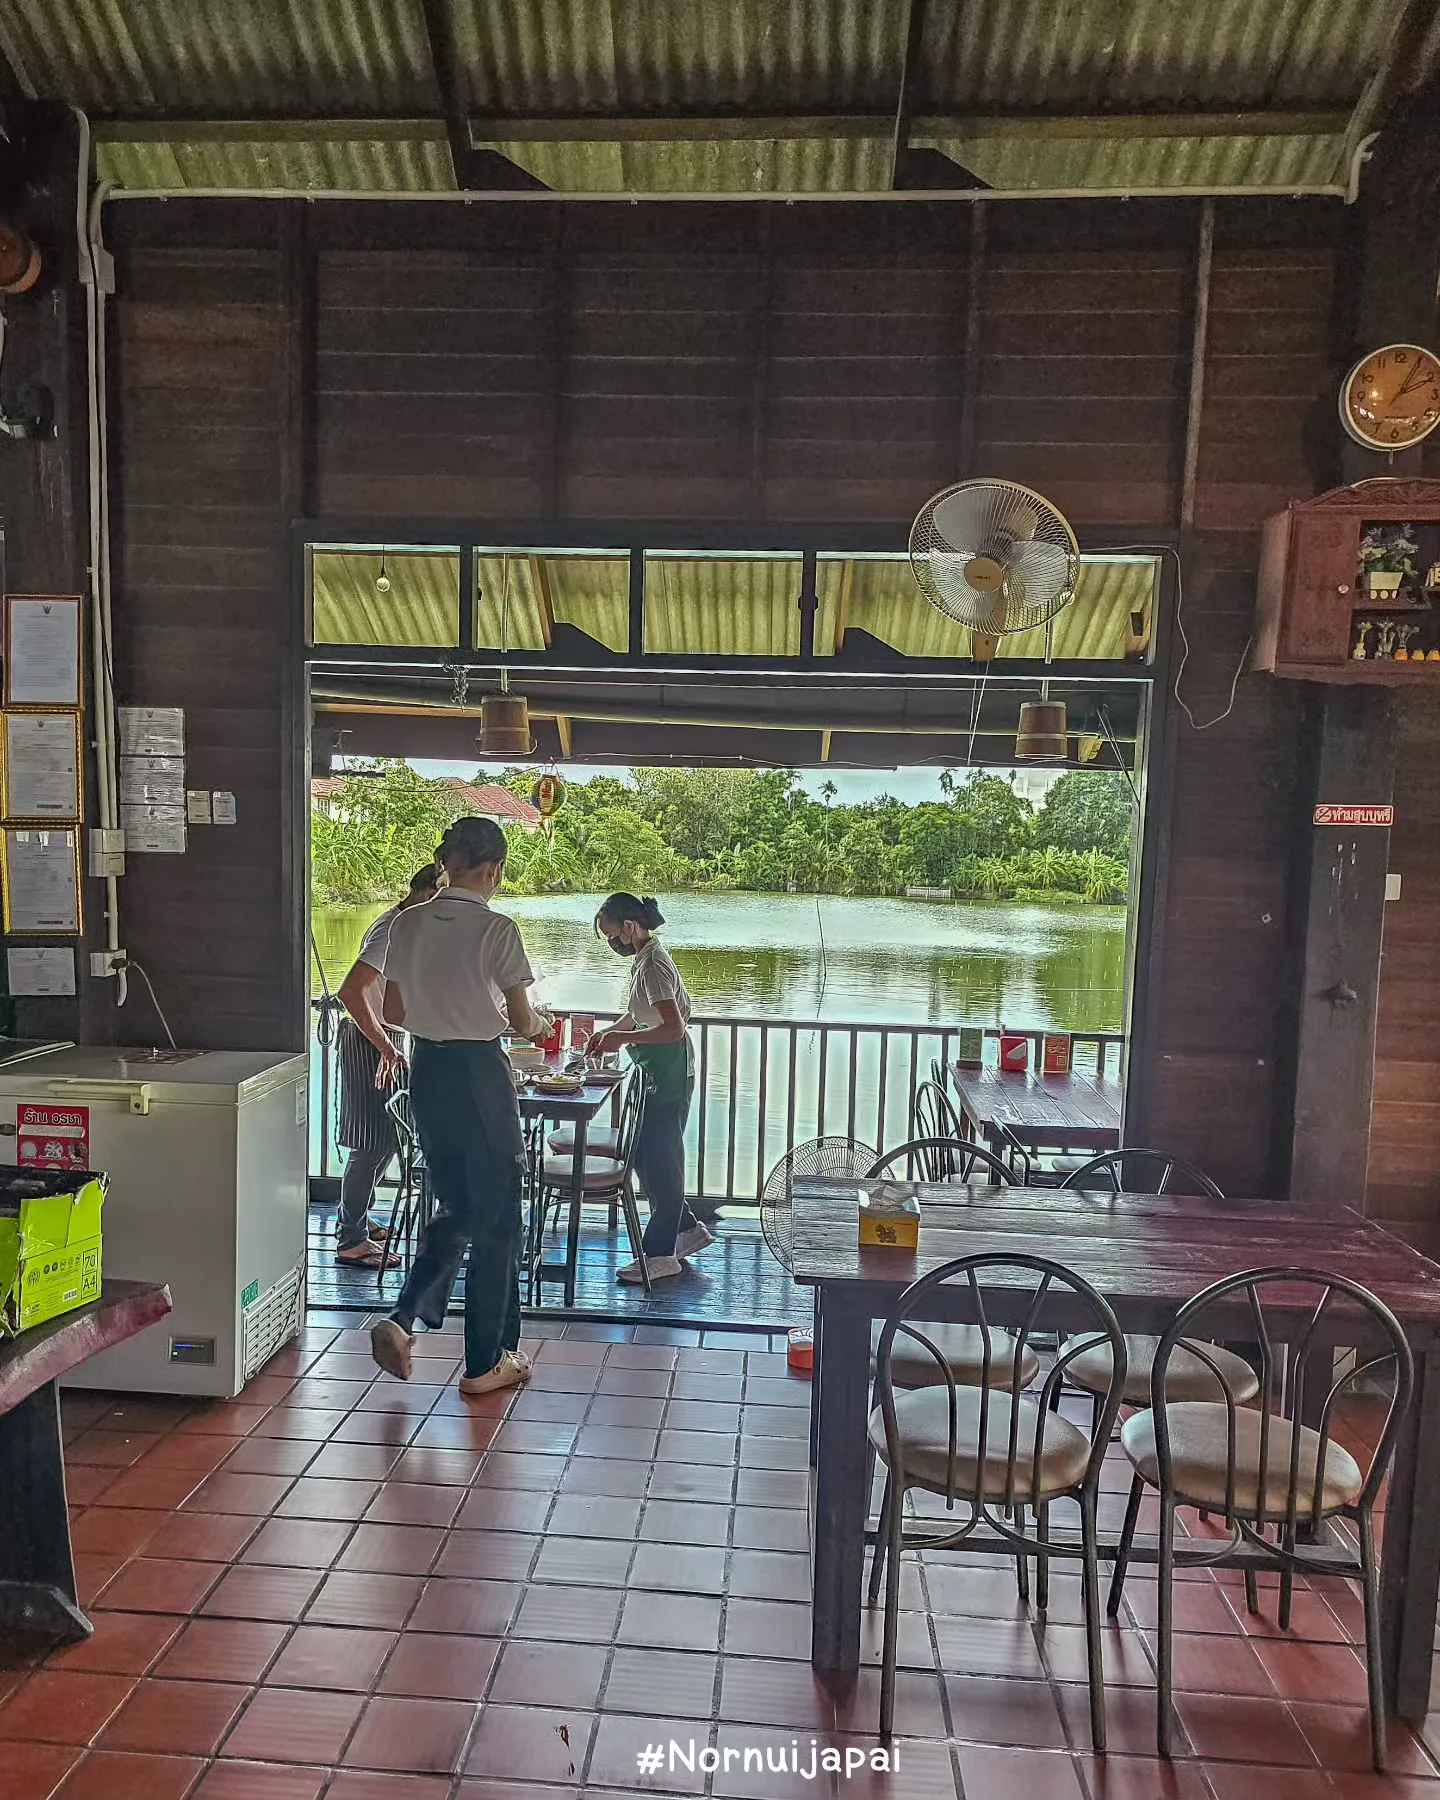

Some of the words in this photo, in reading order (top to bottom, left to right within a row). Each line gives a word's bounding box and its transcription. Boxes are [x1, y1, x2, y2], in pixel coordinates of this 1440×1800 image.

[1378, 358, 1386, 369] 11
[1395, 352, 1406, 363] 12
[1361, 372, 1374, 384] 10
[1356, 390, 1366, 402] 9
[24, 1108, 48, 1124] ร้าน
[84, 1254, 96, 1269] 70
[82, 1275, 96, 1291] A4
